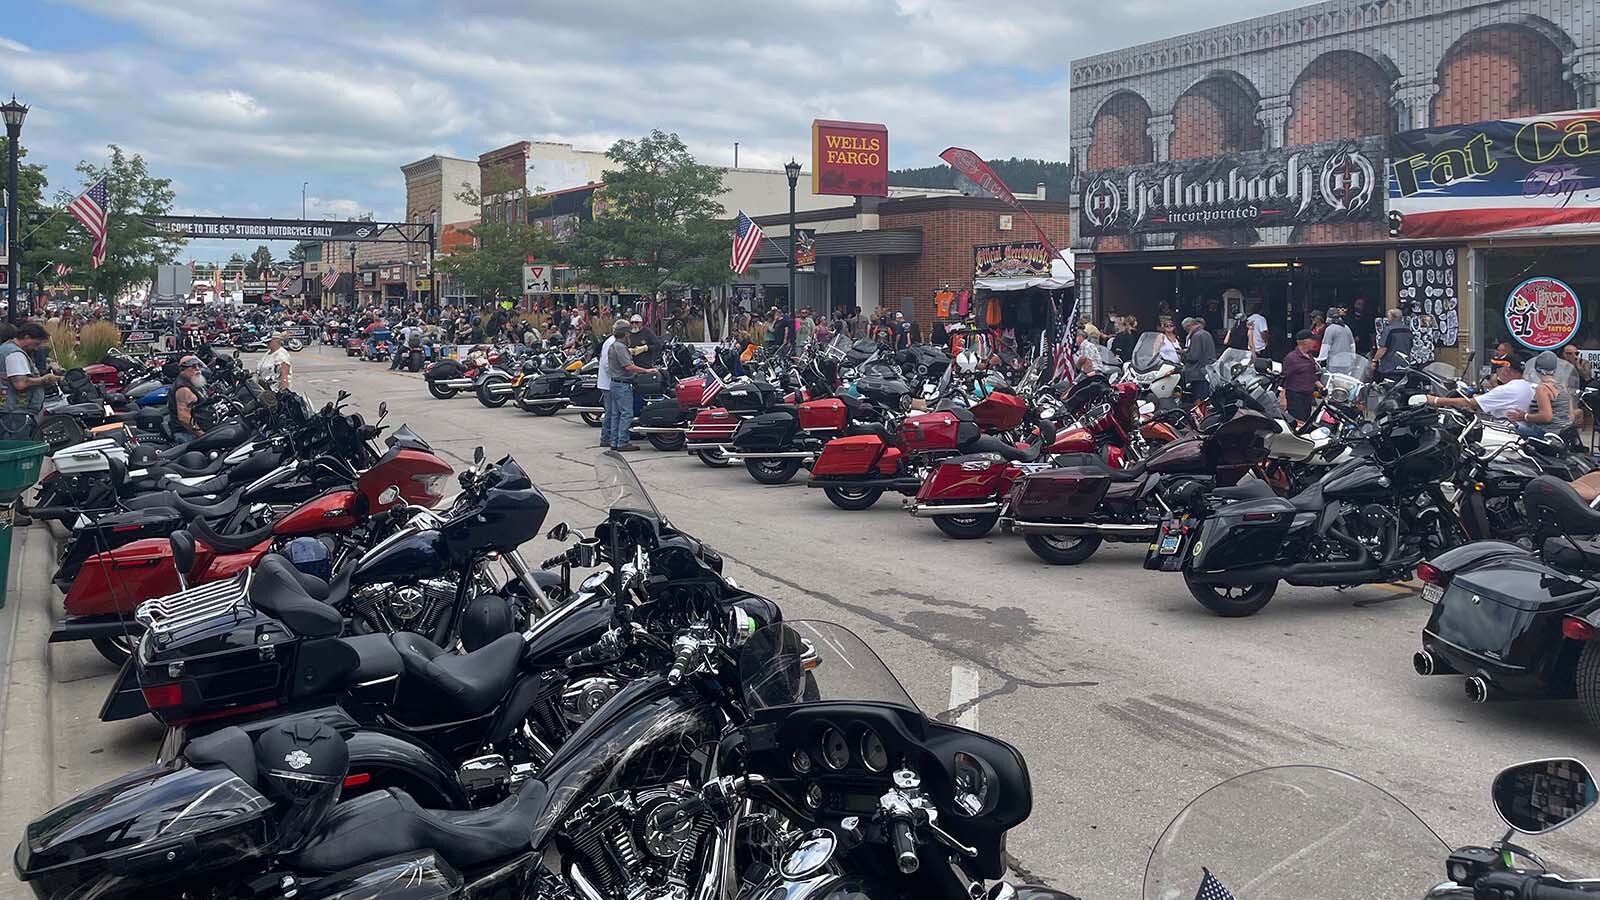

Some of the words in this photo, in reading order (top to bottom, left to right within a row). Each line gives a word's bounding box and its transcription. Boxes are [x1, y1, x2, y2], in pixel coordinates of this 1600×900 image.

[825, 135, 880, 151] WELLS
[827, 151, 880, 166] FARGO
[1393, 132, 1498, 198] Fat
[1168, 205, 1258, 225] incorporated
[194, 223, 203, 233] TO
[204, 223, 218, 234] THE
[236, 224, 266, 235] STURGIS
[267, 225, 312, 236] MOTORCYCLE
[313, 227, 333, 237] RALLY
[1535, 289, 1567, 309] FAT
[1534, 306, 1575, 330] CATS
[1547, 325, 1573, 333] TATTOO
